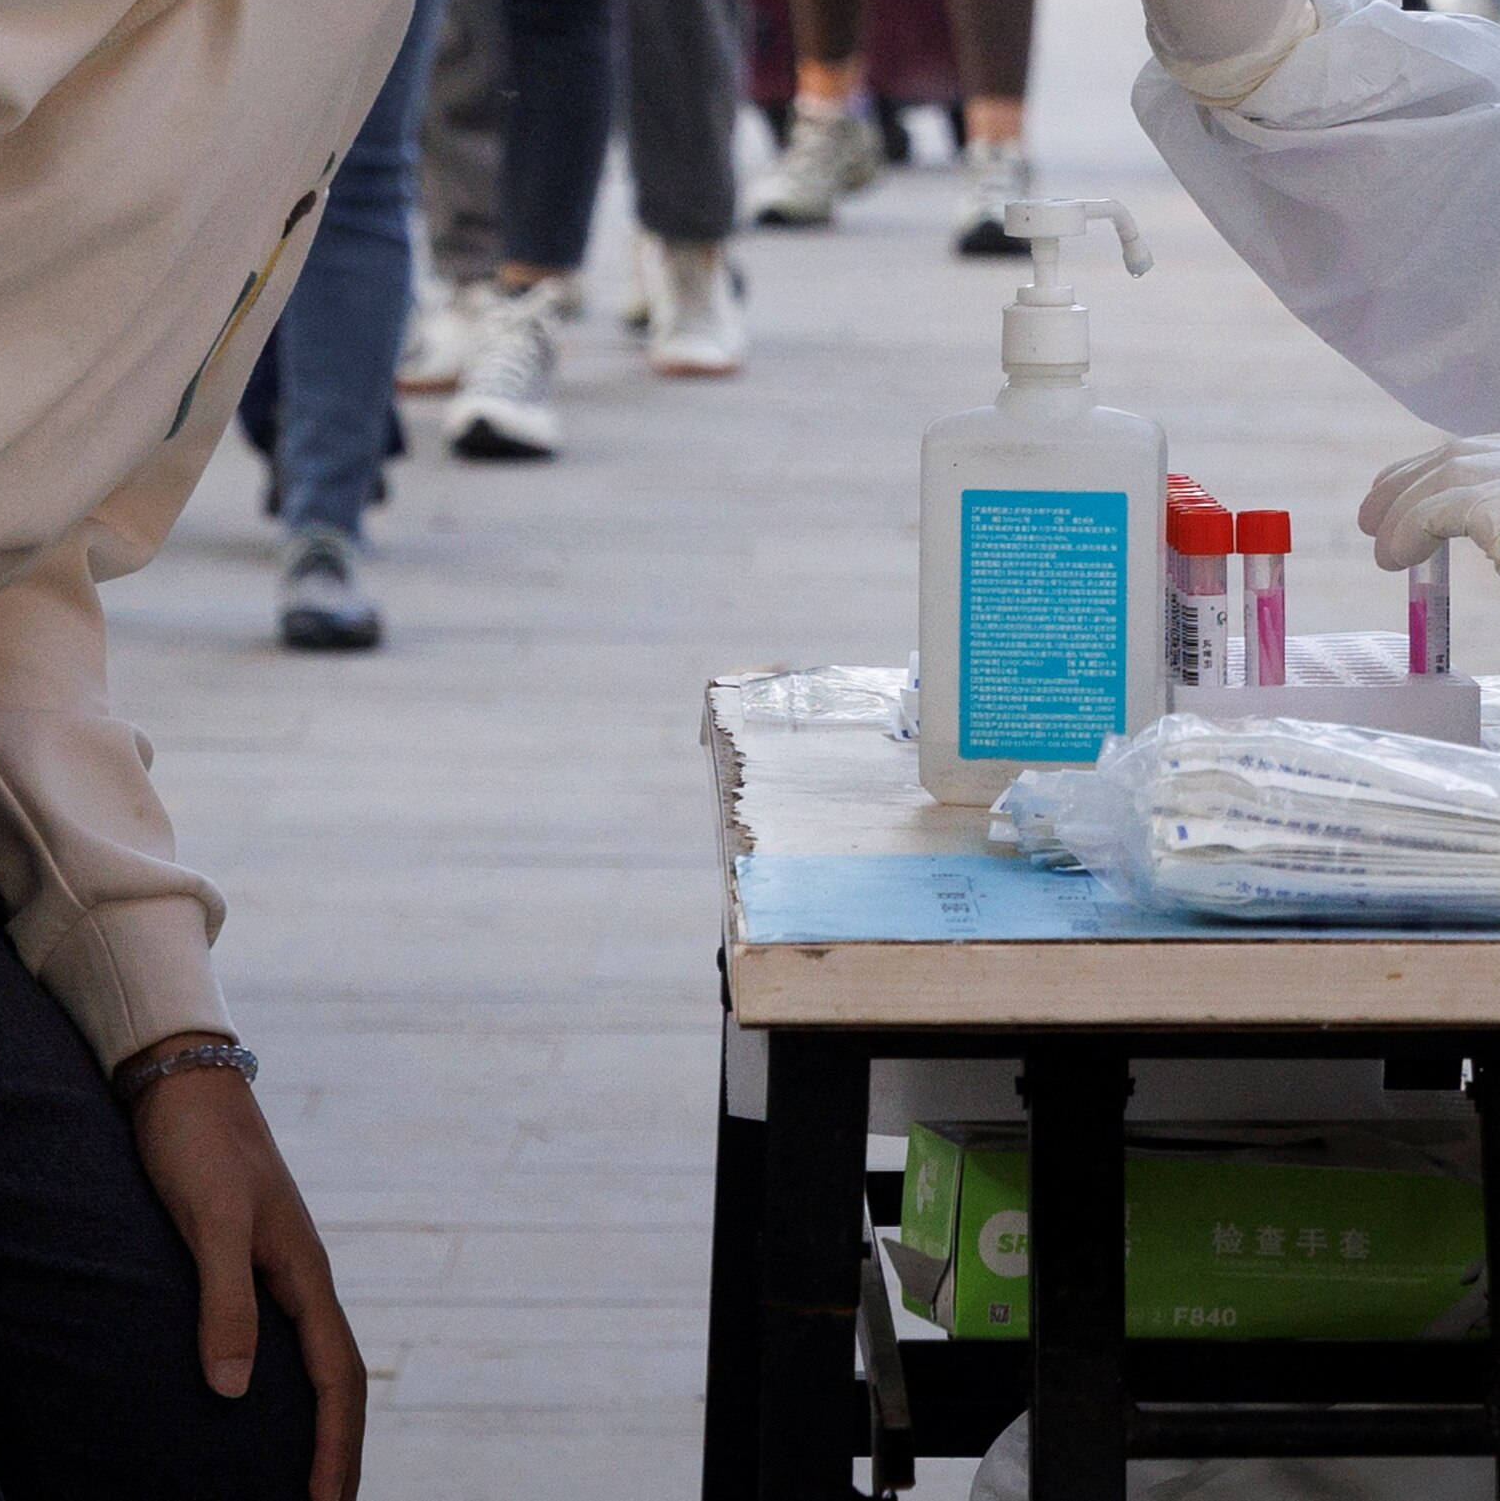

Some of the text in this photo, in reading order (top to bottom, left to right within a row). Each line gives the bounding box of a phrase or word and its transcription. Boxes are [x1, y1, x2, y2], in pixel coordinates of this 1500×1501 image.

[1211, 1221, 1371, 1259] 检查手套
[1173, 1306, 1237, 1327] F840
